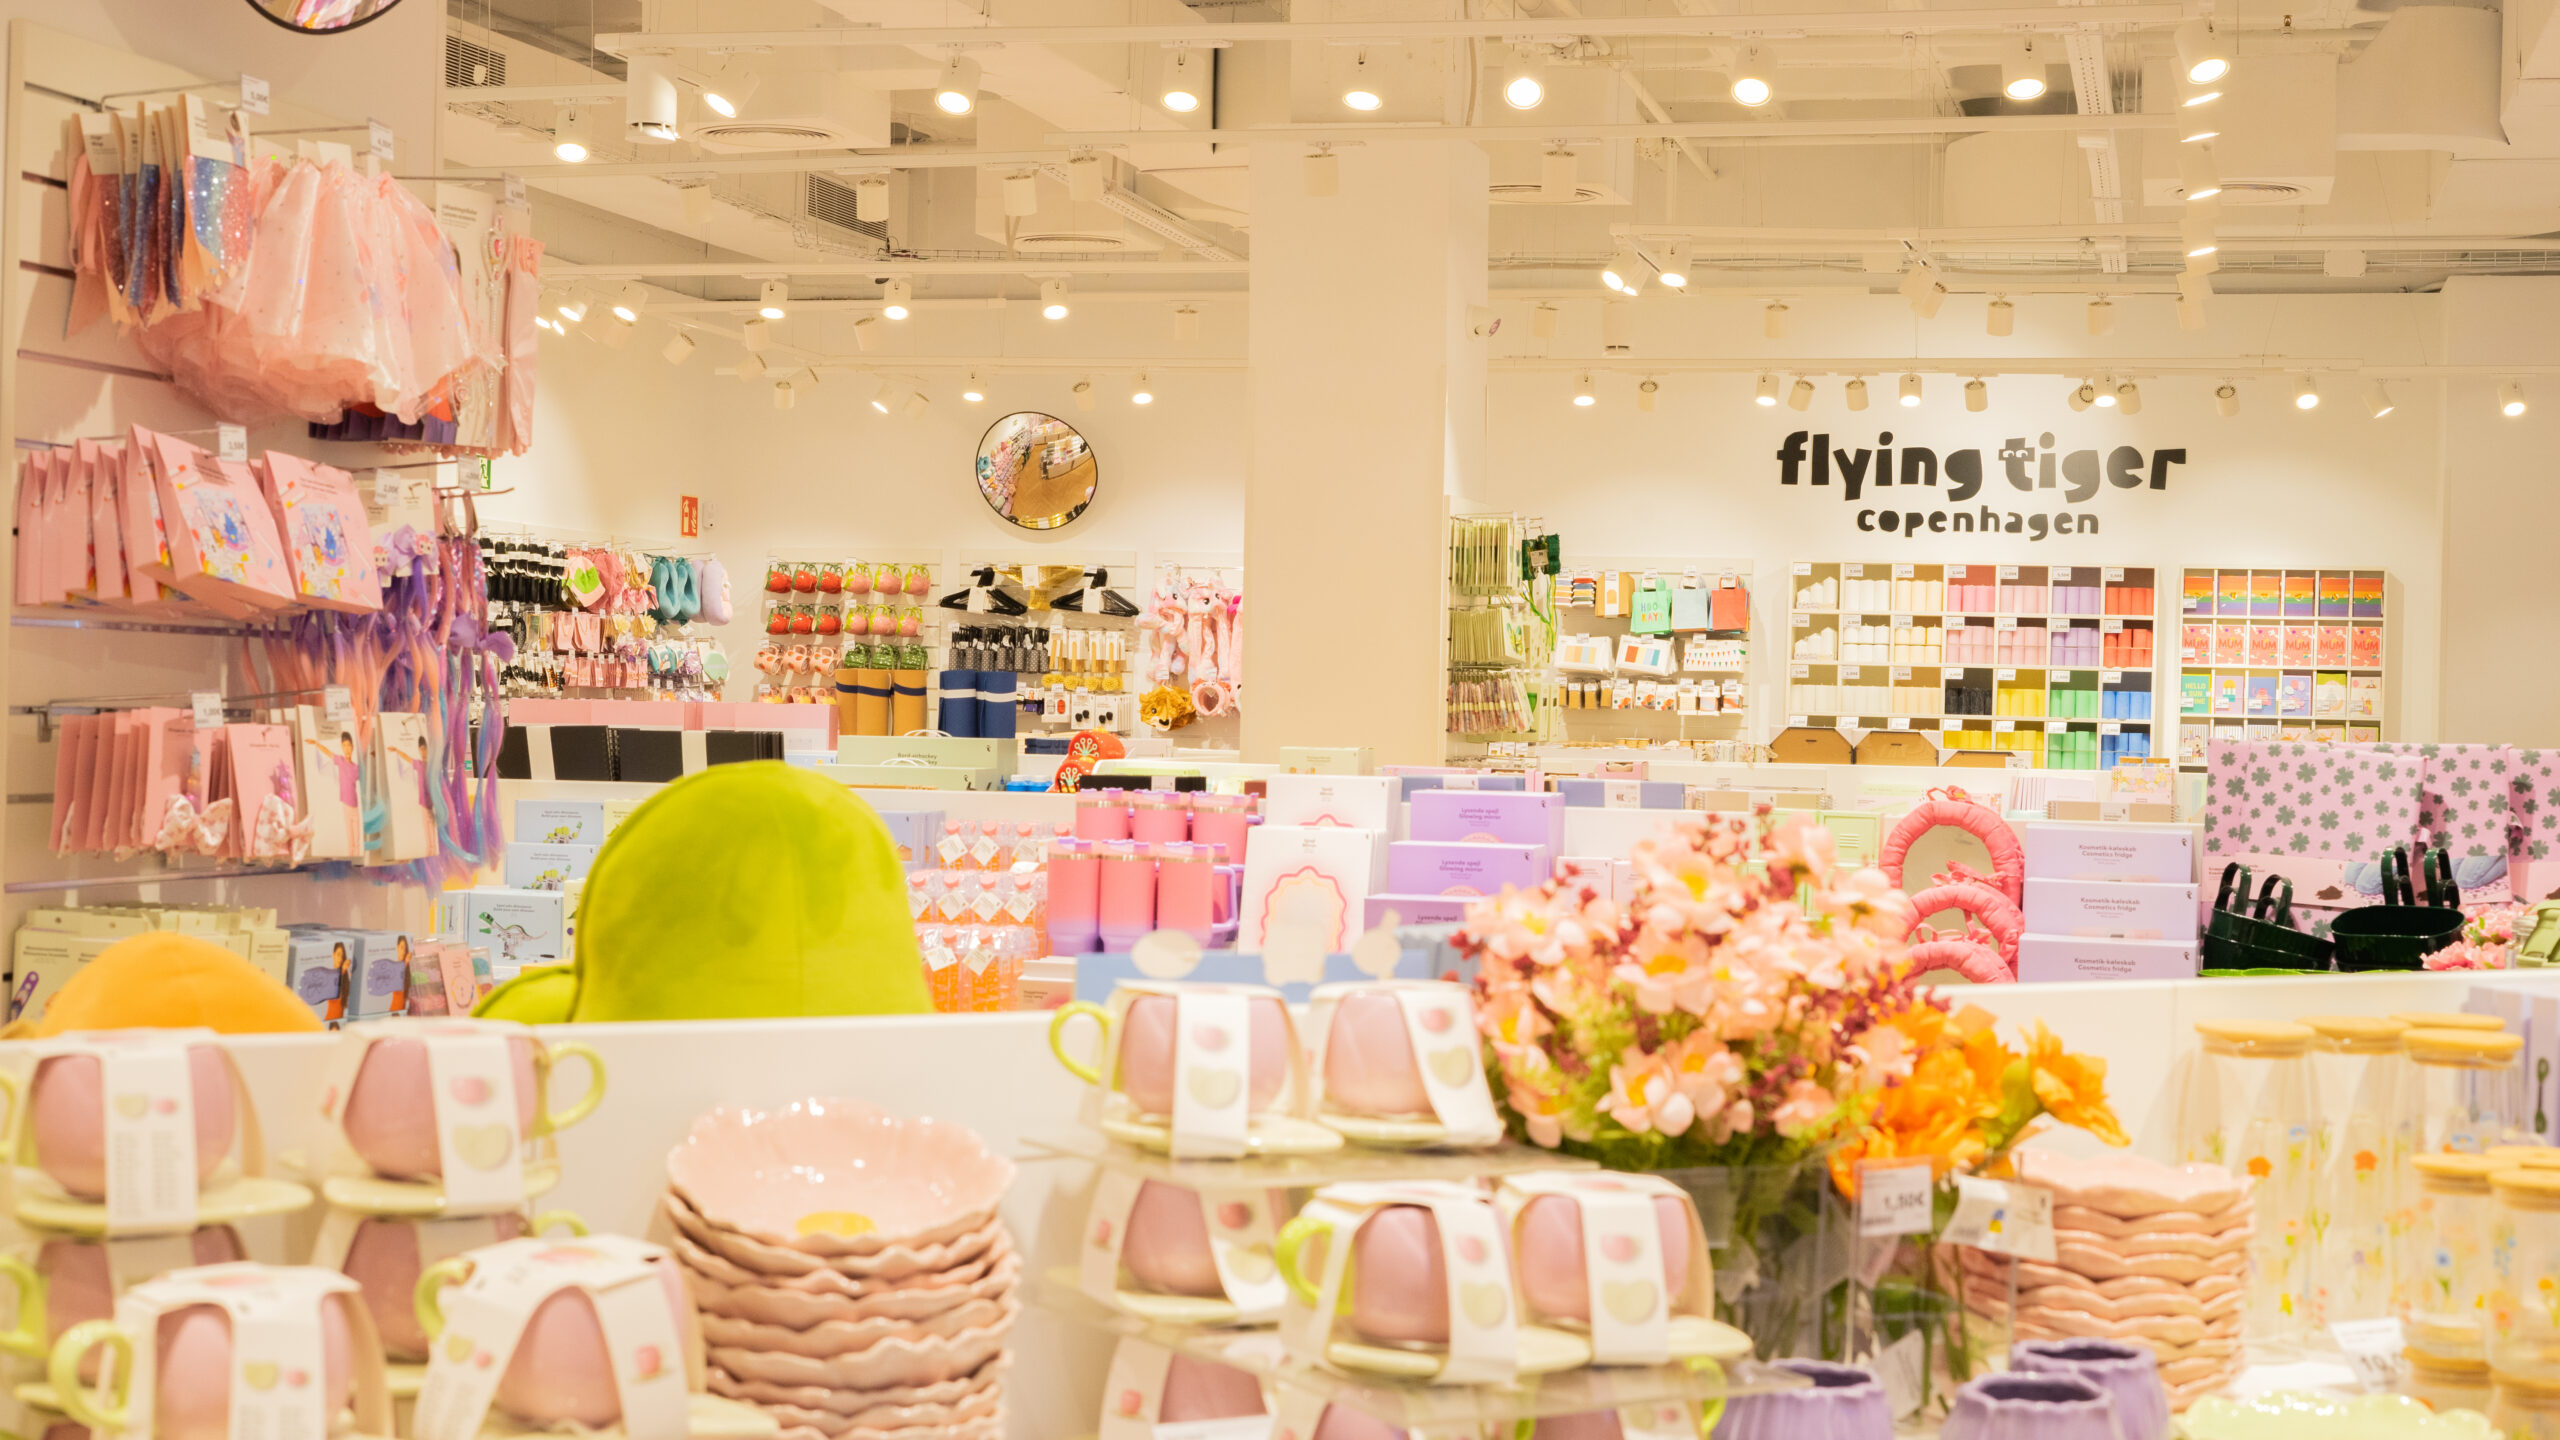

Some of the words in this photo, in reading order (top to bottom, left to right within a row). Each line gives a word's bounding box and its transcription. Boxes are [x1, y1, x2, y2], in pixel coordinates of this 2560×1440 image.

[1777, 430, 1983, 502] flying
[1998, 431, 2186, 503] tiger
[1857, 505, 2099, 541] copenhagen
[2184, 639, 2209, 649] MUM
[2218, 639, 2243, 649] MUM
[2252, 640, 2277, 650] MUM
[2285, 640, 2310, 650] MUM
[2319, 640, 2345, 650] MUM
[2354, 640, 2379, 651] MUM
[2114, 852, 2133, 860] fridge
[2117, 905, 2137, 913] fridge
[2077, 965, 2111, 973] Cosmetics
[2112, 966, 2133, 975] fridge
